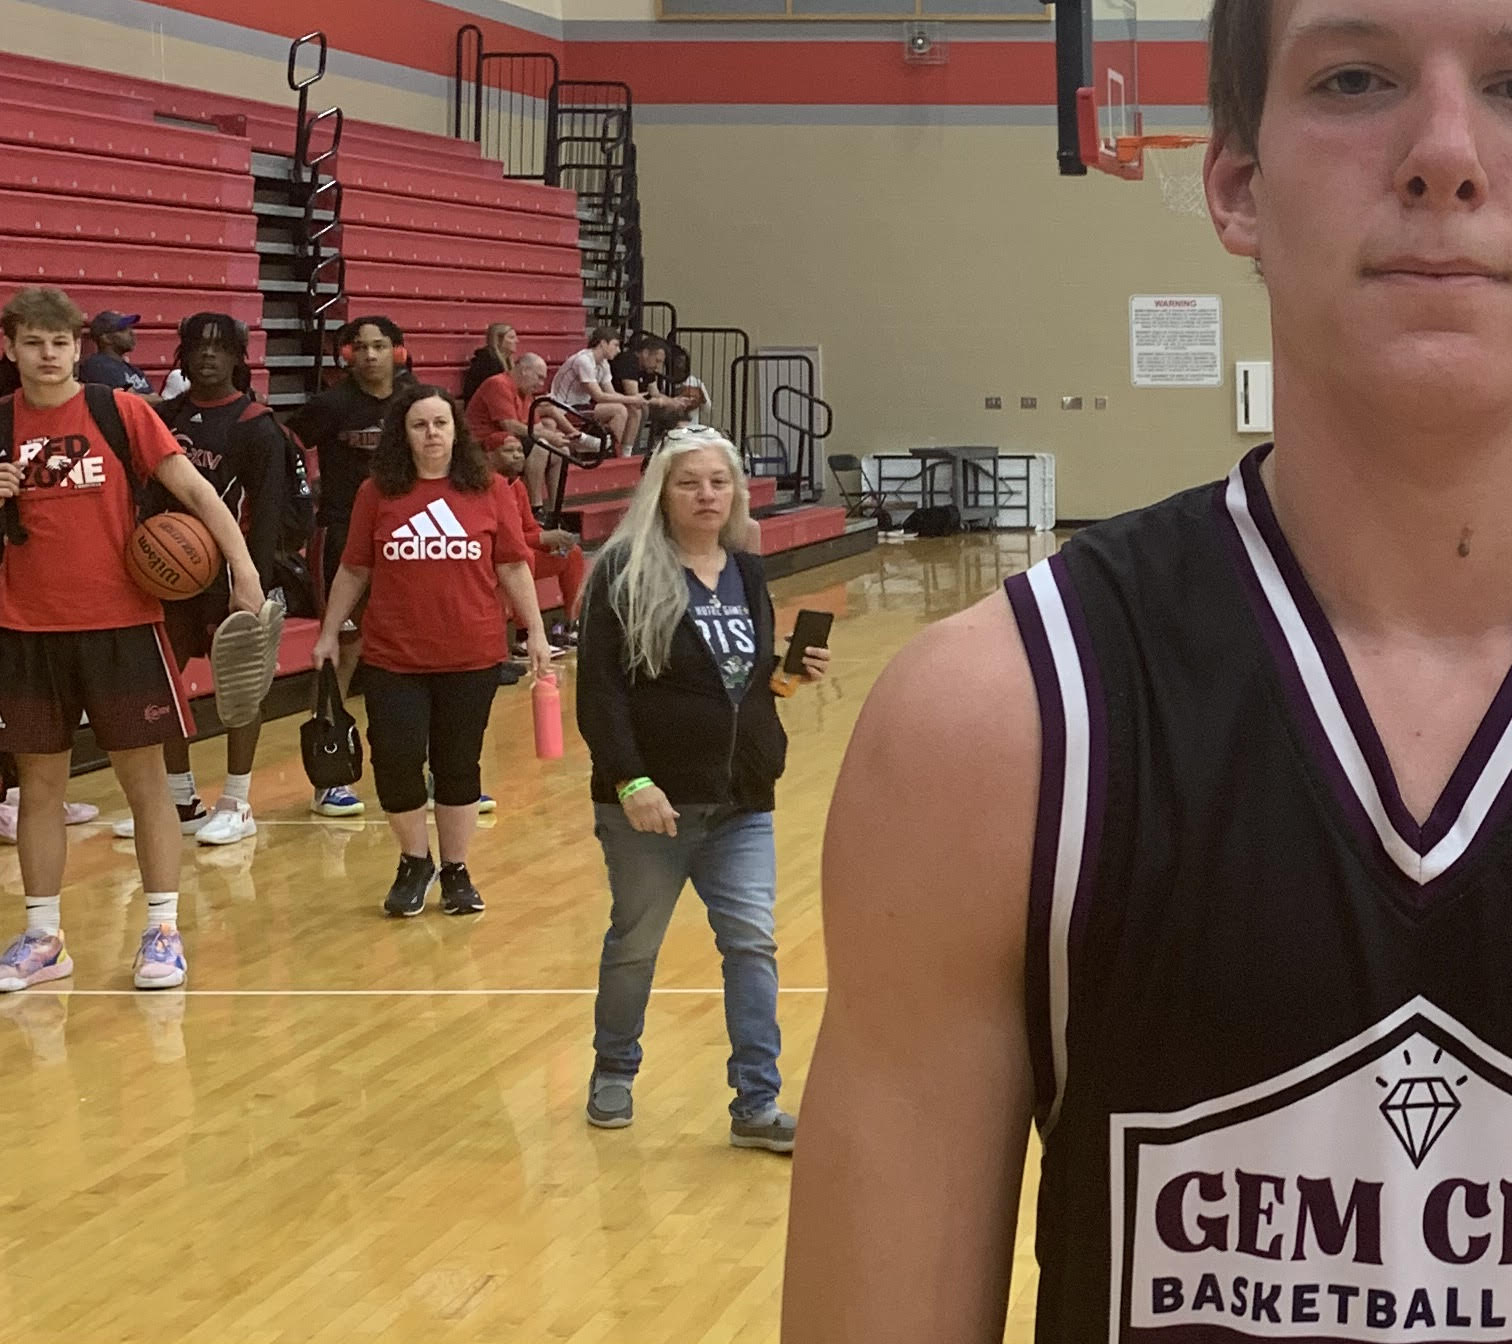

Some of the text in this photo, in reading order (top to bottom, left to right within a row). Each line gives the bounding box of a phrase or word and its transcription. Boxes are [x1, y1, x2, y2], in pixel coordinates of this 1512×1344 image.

[1154, 299, 1197, 307] WARNING
[20, 434, 91, 466] RED
[138, 535, 180, 585] Wilson
[383, 535, 482, 560] adidas
[1153, 1168, 1384, 1265] GEM
[1151, 1273, 1506, 1330] BASKETBALL
